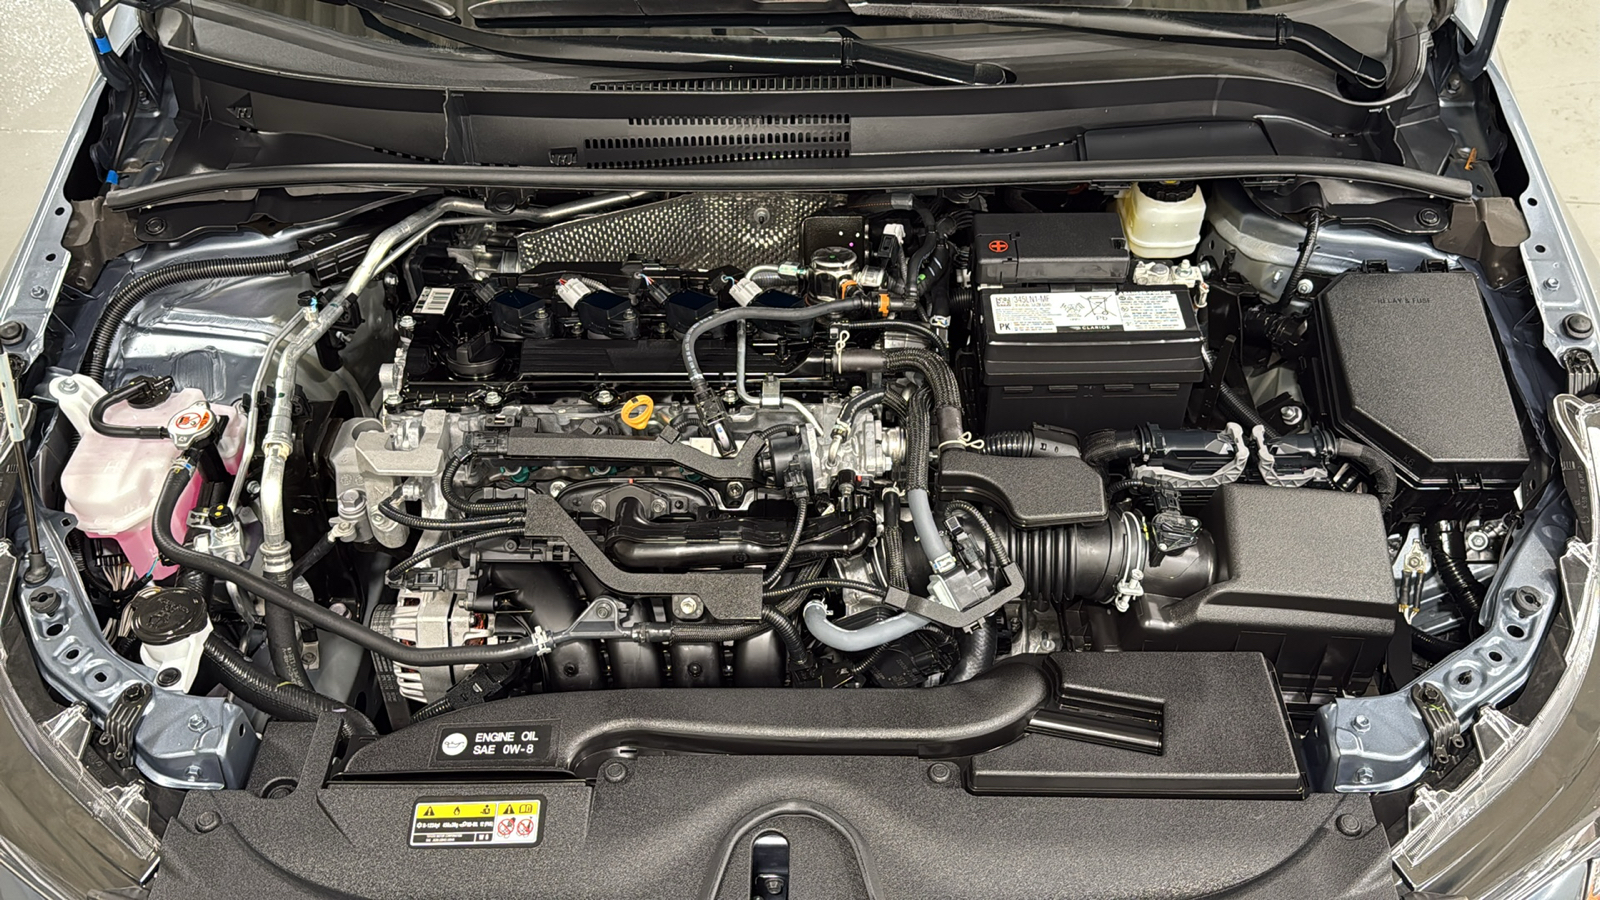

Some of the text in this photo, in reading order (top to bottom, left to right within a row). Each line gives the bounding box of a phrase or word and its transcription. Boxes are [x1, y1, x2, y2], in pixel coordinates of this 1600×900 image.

[999, 323, 1011, 331] PK
[475, 731, 539, 742] ENGINE OIL
[473, 744, 534, 755] SAE 0W-8
